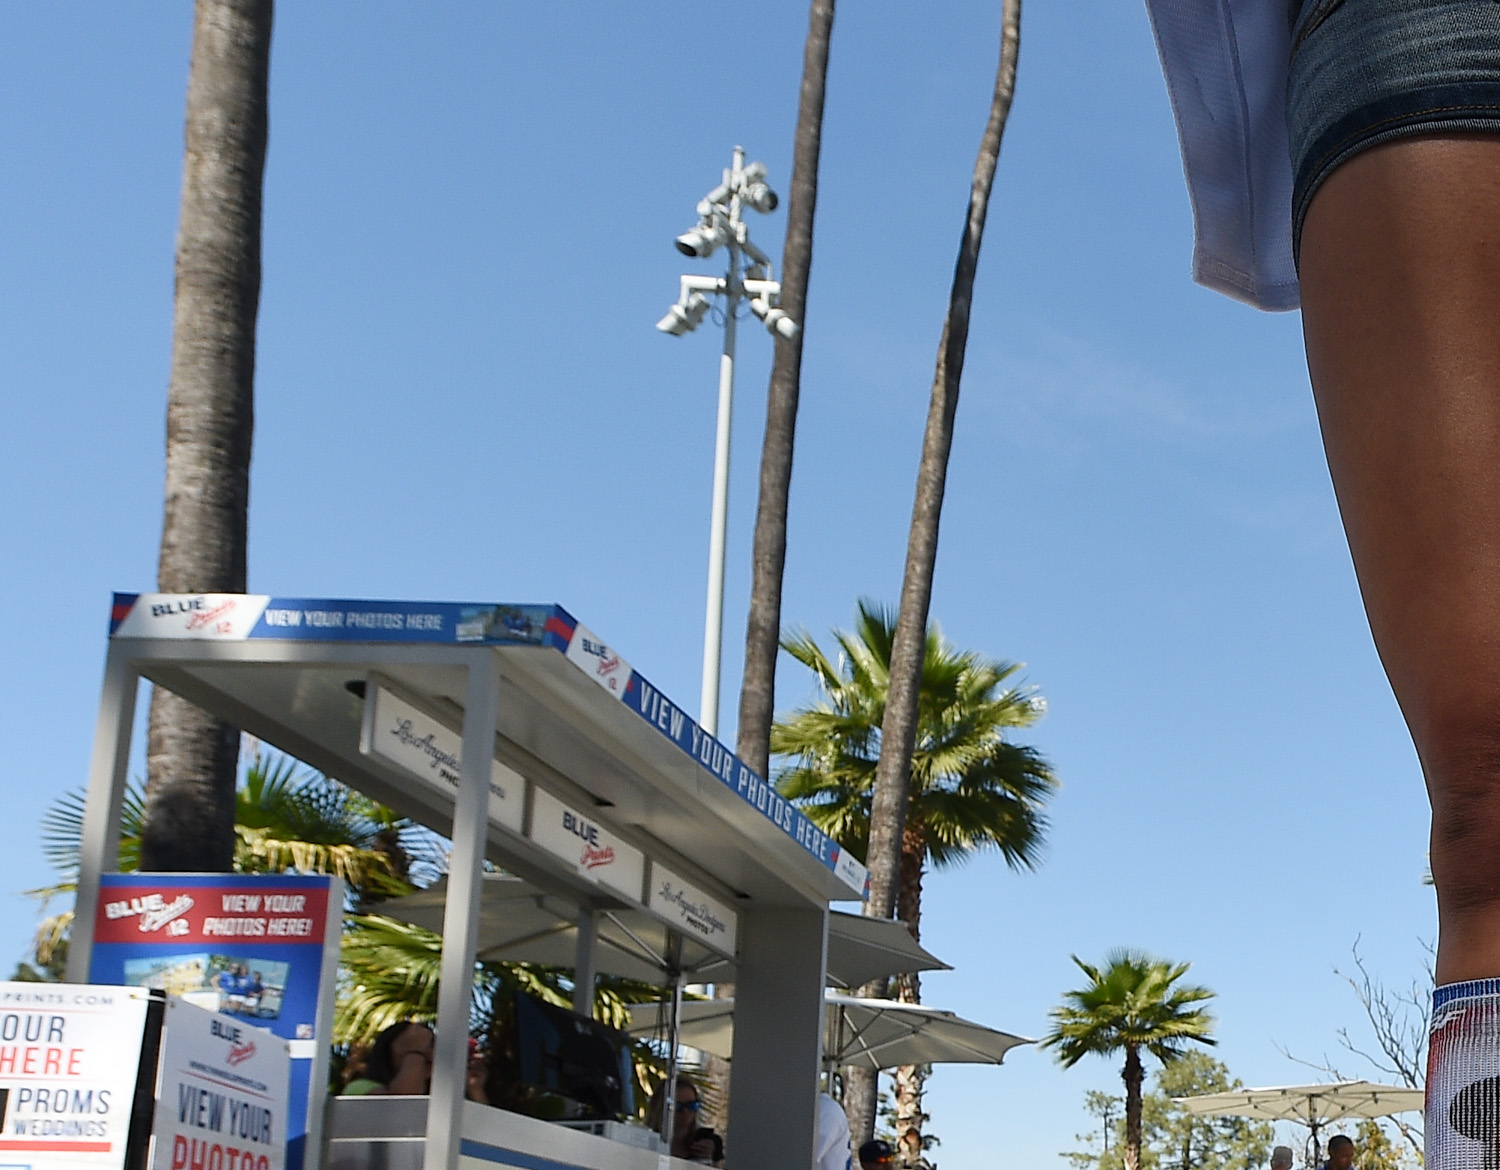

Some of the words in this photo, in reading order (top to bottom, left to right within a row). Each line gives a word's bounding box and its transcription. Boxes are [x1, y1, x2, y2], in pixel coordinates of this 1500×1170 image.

[152, 597, 206, 617] BLUE
[264, 609, 301, 627] VIEW
[304, 610, 344, 629] YOUR
[346, 612, 403, 629] PHOTOS
[405, 613, 444, 631] HERE
[581, 638, 609, 660] BLUE
[640, 680, 685, 741] VIEW
[691, 723, 734, 783] YOUR
[737, 767, 794, 833] PHOTOS
[796, 815, 828, 862] HERE
[562, 811, 600, 848] BLUE
[105, 894, 164, 920] BLUE
[222, 894, 261, 912] VIEW
[263, 894, 306, 912] YOUR
[202, 917, 266, 937] PHOTOS
[267, 918, 314, 937] HERE!
[0, 1014, 66, 1043] OUR
[210, 1019, 243, 1046] BLUE
[0, 1046, 84, 1076] HERE
[16, 1087, 113, 1115] PROMS
[178, 1082, 227, 1133] VIEW
[227, 1096, 273, 1146] YOUR
[13, 1118, 109, 1138] WEDDINGS
